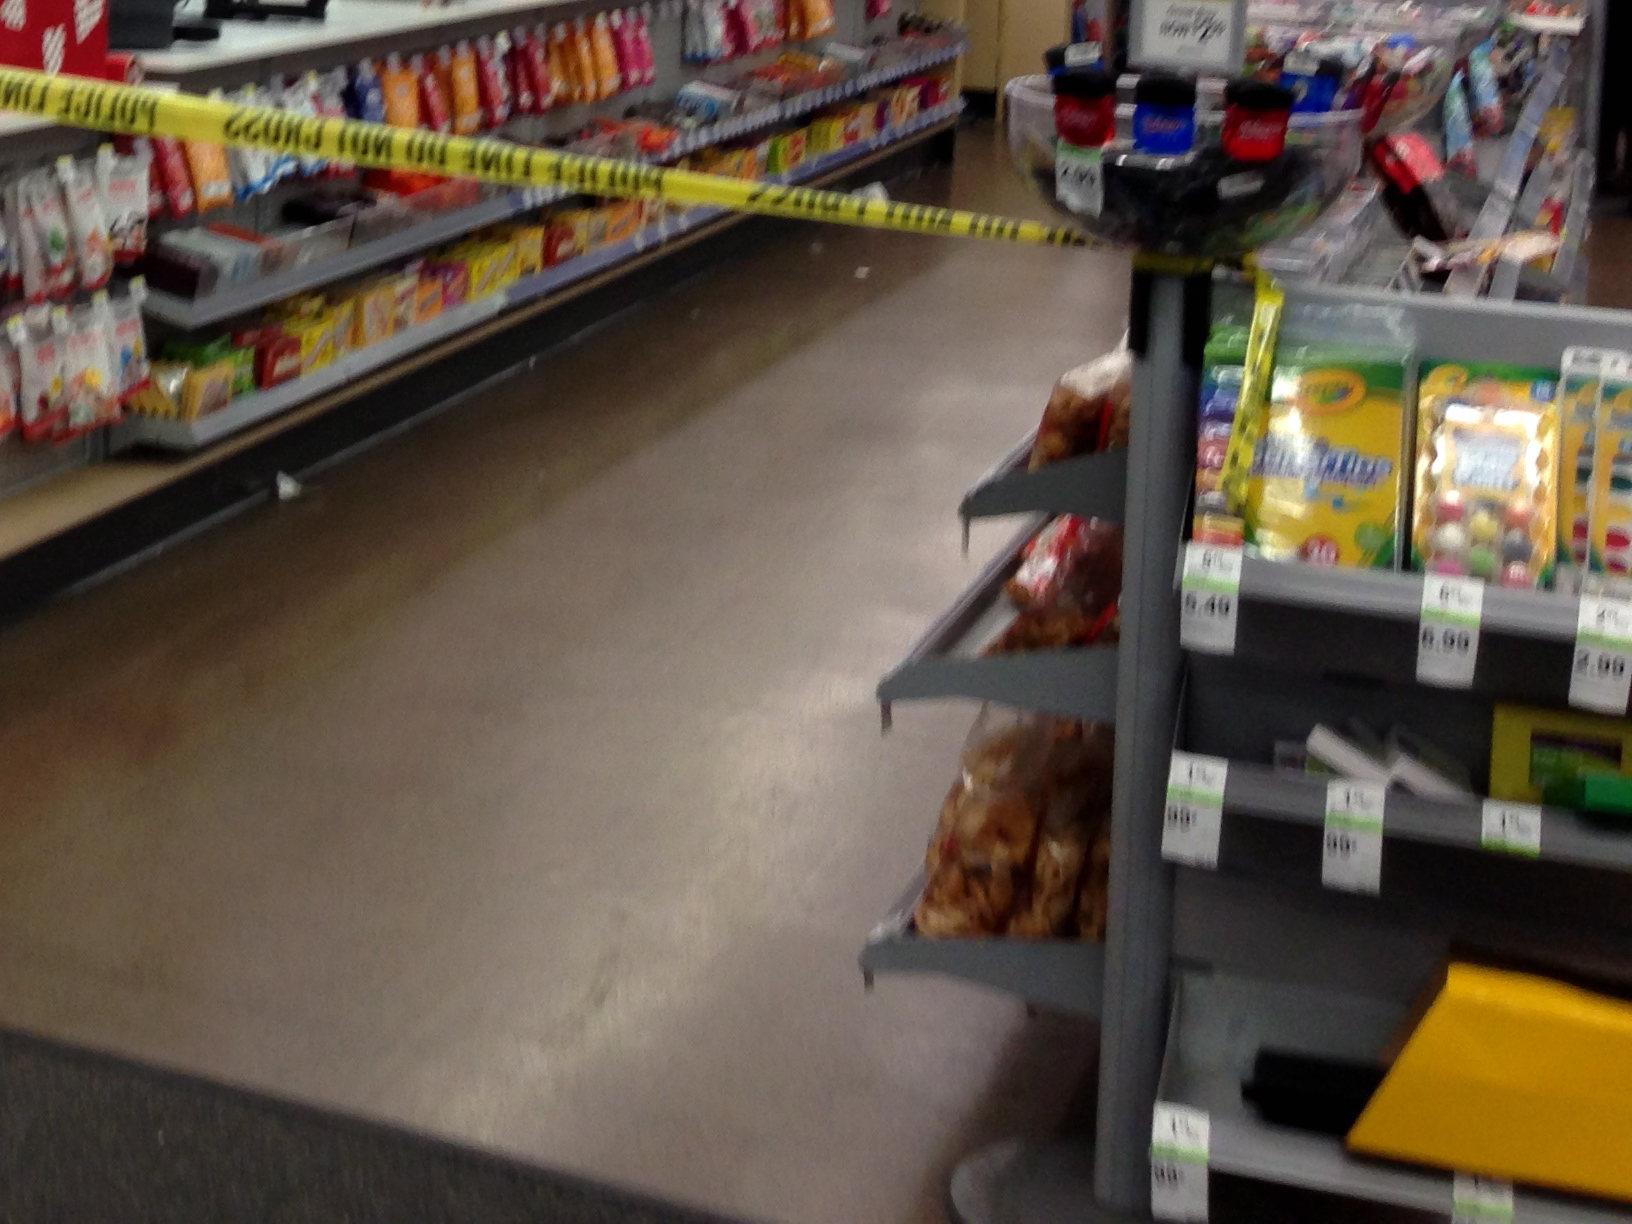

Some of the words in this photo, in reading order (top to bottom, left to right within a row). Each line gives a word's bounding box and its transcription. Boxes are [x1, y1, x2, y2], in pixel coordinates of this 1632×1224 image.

[60, 84, 159, 133] POLICE
[223, 108, 325, 152] CROSS
[337, 121, 394, 158] NOT
[404, 133, 450, 167] DO
[462, 138, 536, 180] LINE
[549, 152, 665, 196] POLICE
